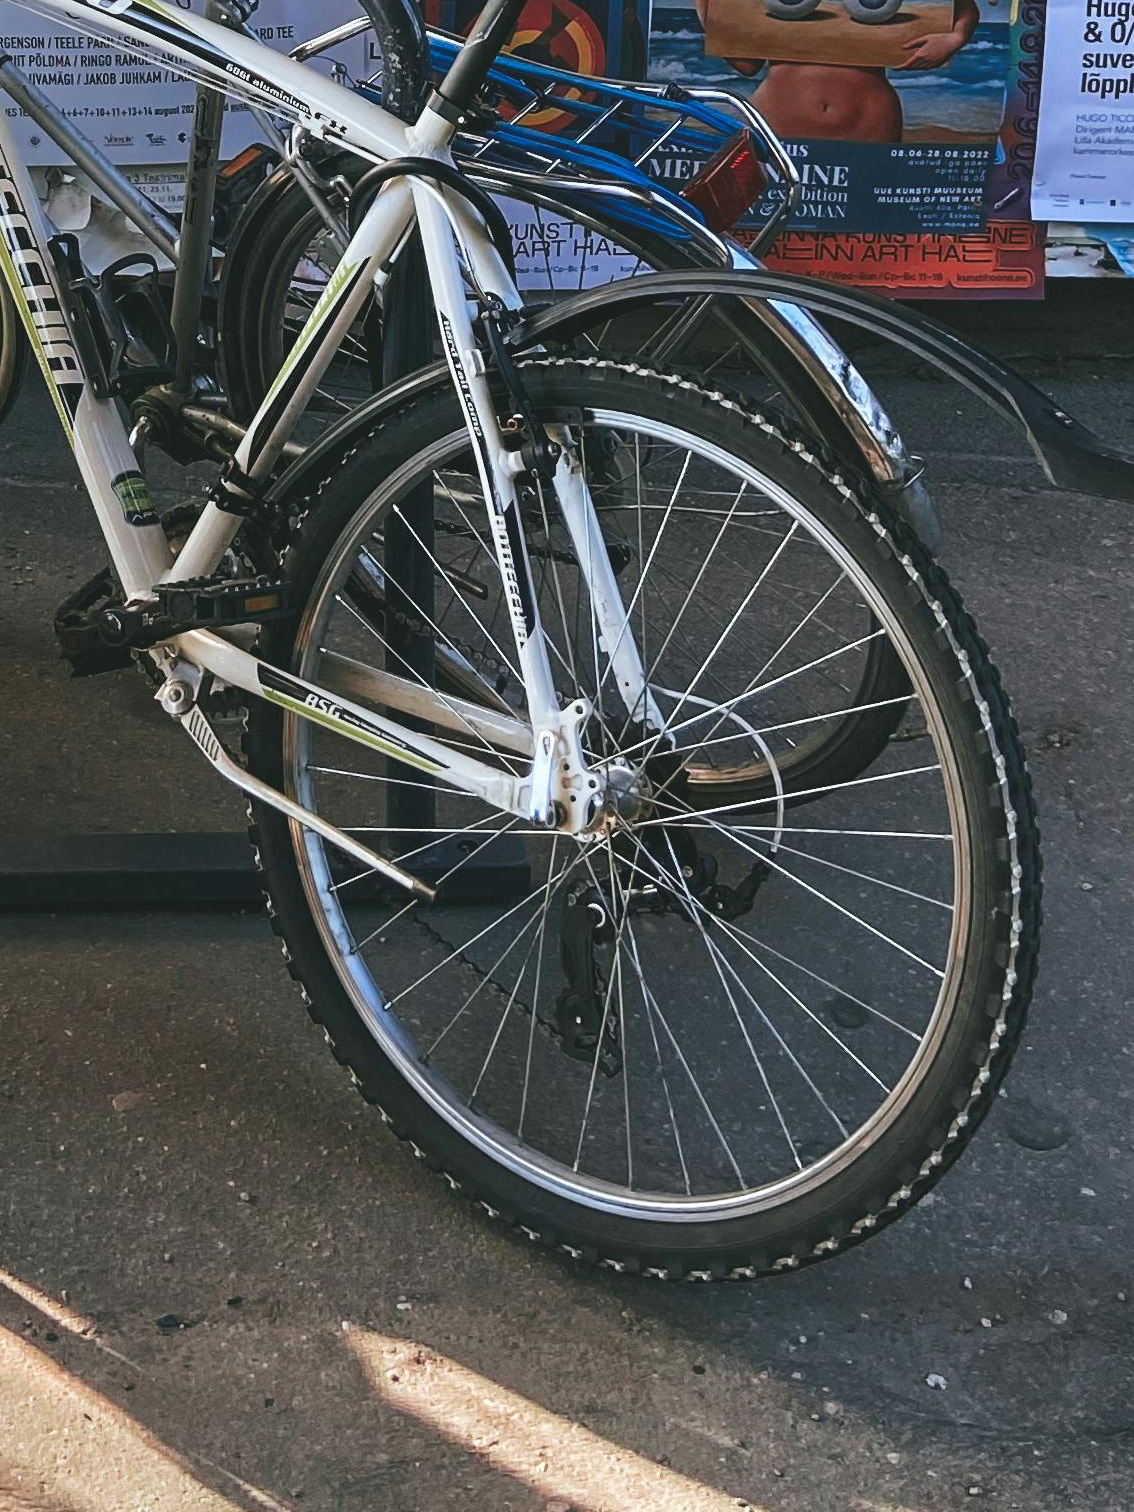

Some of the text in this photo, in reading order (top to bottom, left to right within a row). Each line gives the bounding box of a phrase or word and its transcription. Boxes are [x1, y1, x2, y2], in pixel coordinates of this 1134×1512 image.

[275, 25, 295, 39] TEE
[54, 36, 85, 49] TEELE
[80, 54, 113, 67] RINGO
[83, 71, 162, 86] JAKOB JUHKAM
[252, 77, 312, 117] aluminium
[877, 195, 920, 205] MUSEUM
[962, 196, 983, 205] ART
[866, 245, 911, 263] ART
[442, 320, 460, 358] Hard
